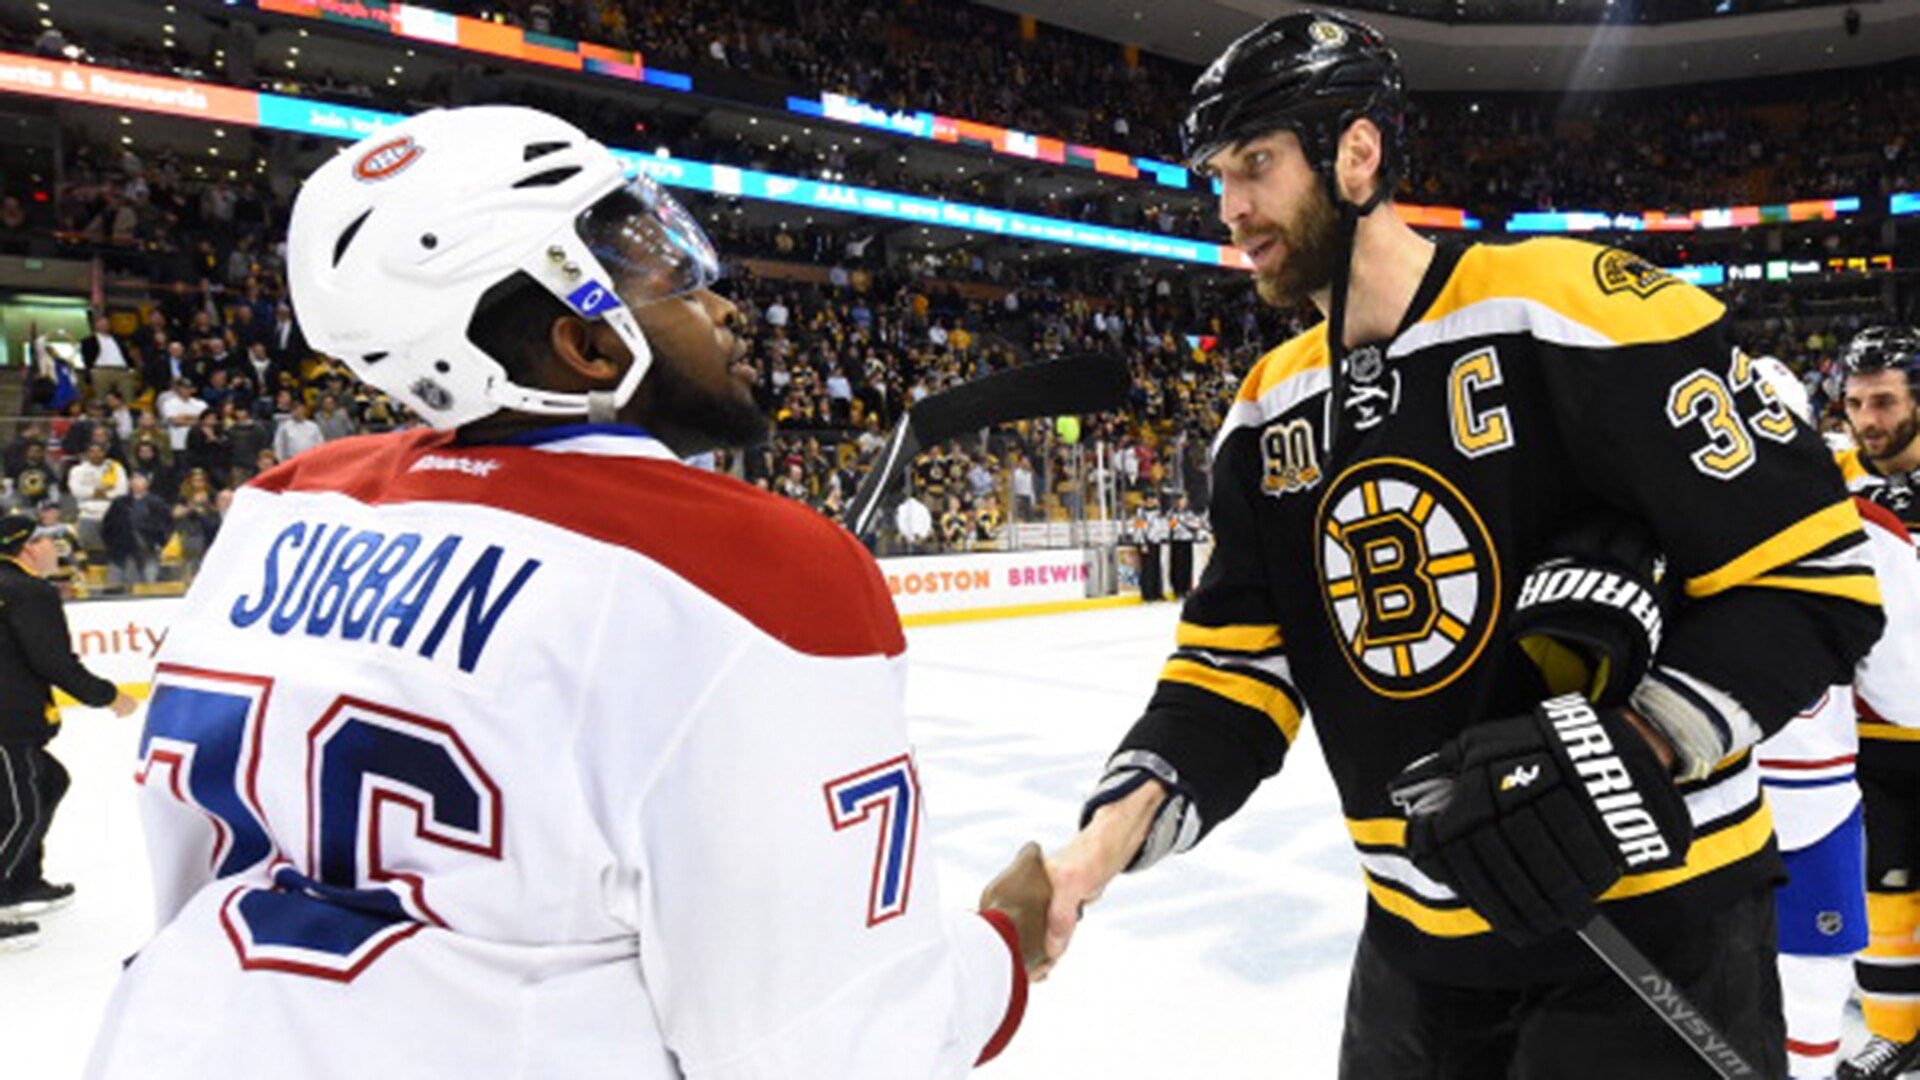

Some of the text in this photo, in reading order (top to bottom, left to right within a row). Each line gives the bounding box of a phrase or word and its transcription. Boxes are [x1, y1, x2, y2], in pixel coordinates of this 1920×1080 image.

[1447, 345, 1514, 459] C
[230, 521, 542, 674] SUBBAN
[887, 569, 990, 595] BOSTON
[1340, 511, 1441, 647] B
[134, 662, 503, 983] 76
